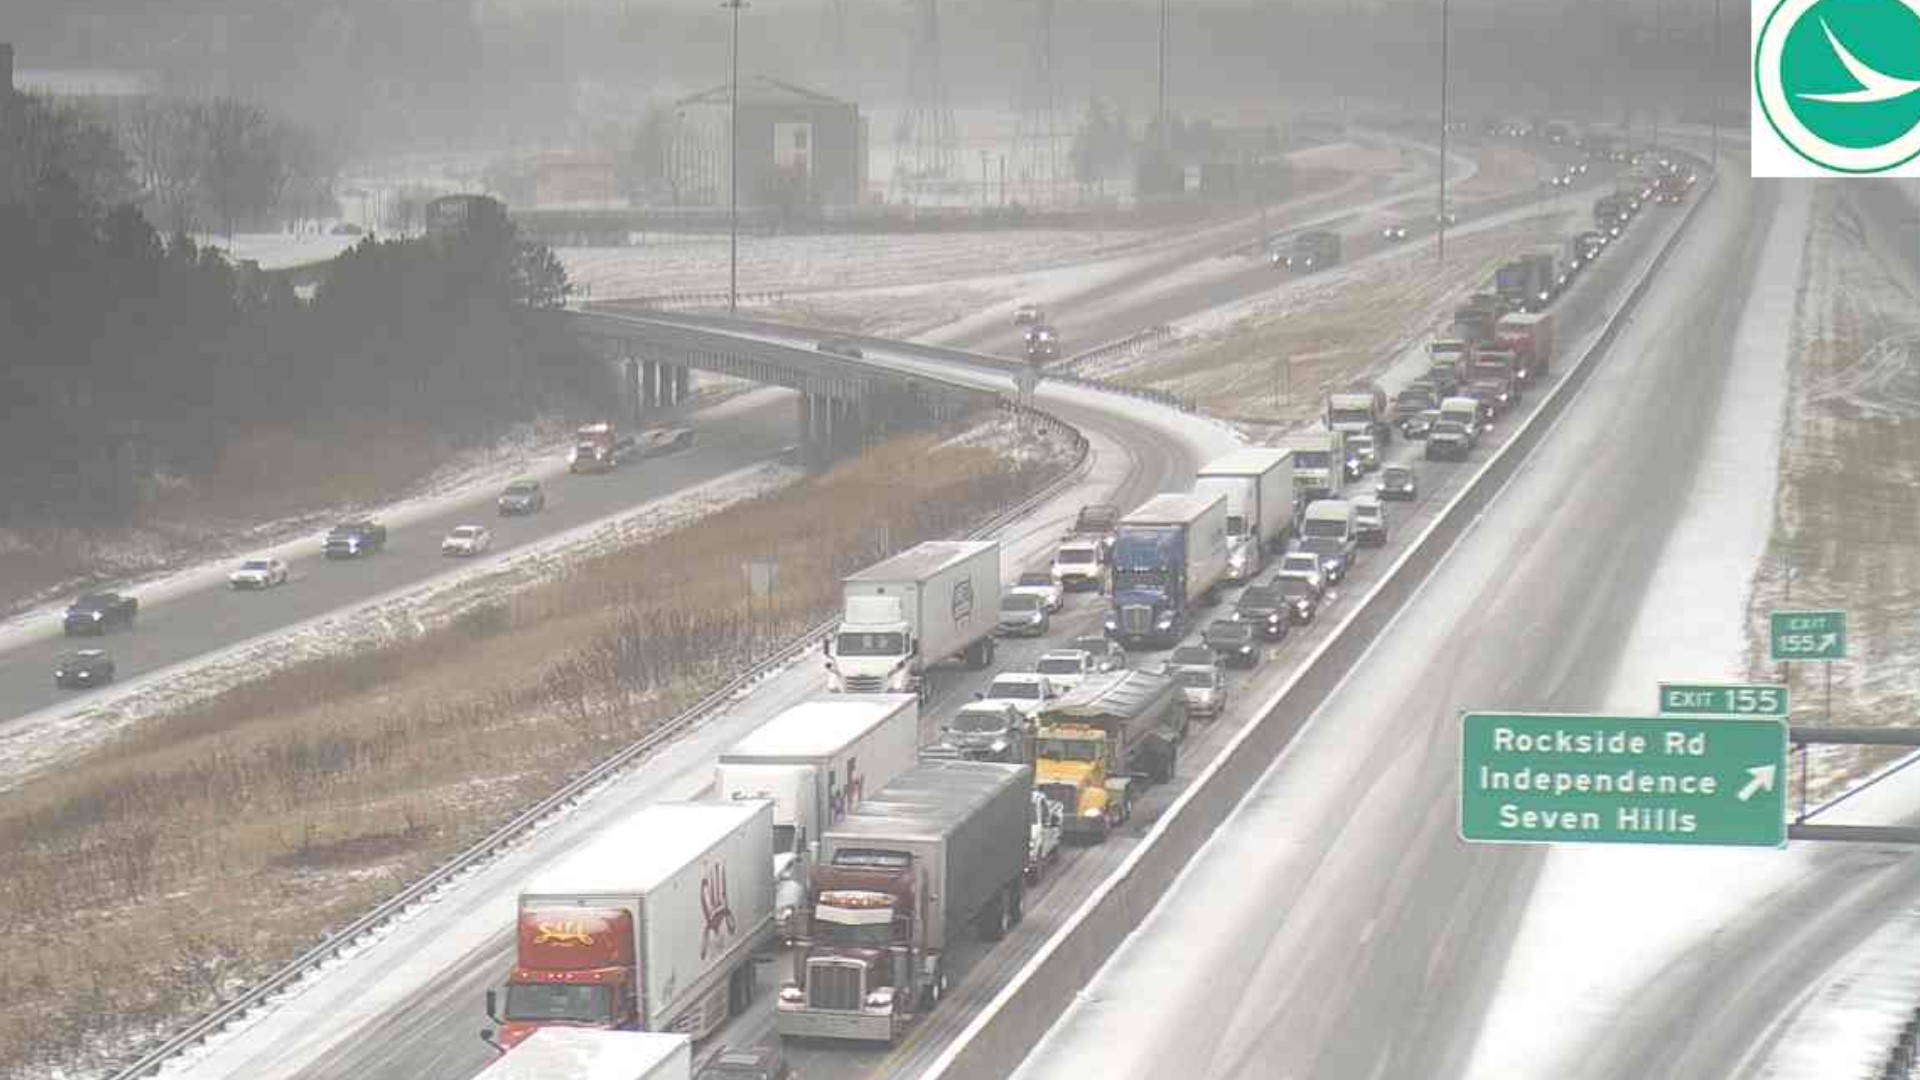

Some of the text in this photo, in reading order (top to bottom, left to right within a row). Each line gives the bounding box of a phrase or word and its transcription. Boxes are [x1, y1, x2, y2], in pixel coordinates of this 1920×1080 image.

[1778, 635, 1815, 652] 155
[1669, 689, 1779, 712] EXIT 155
[1494, 727, 1706, 757] Rockside Rd
[1479, 765, 1718, 795] Independence
[1499, 804, 1698, 832] Seven Hills
